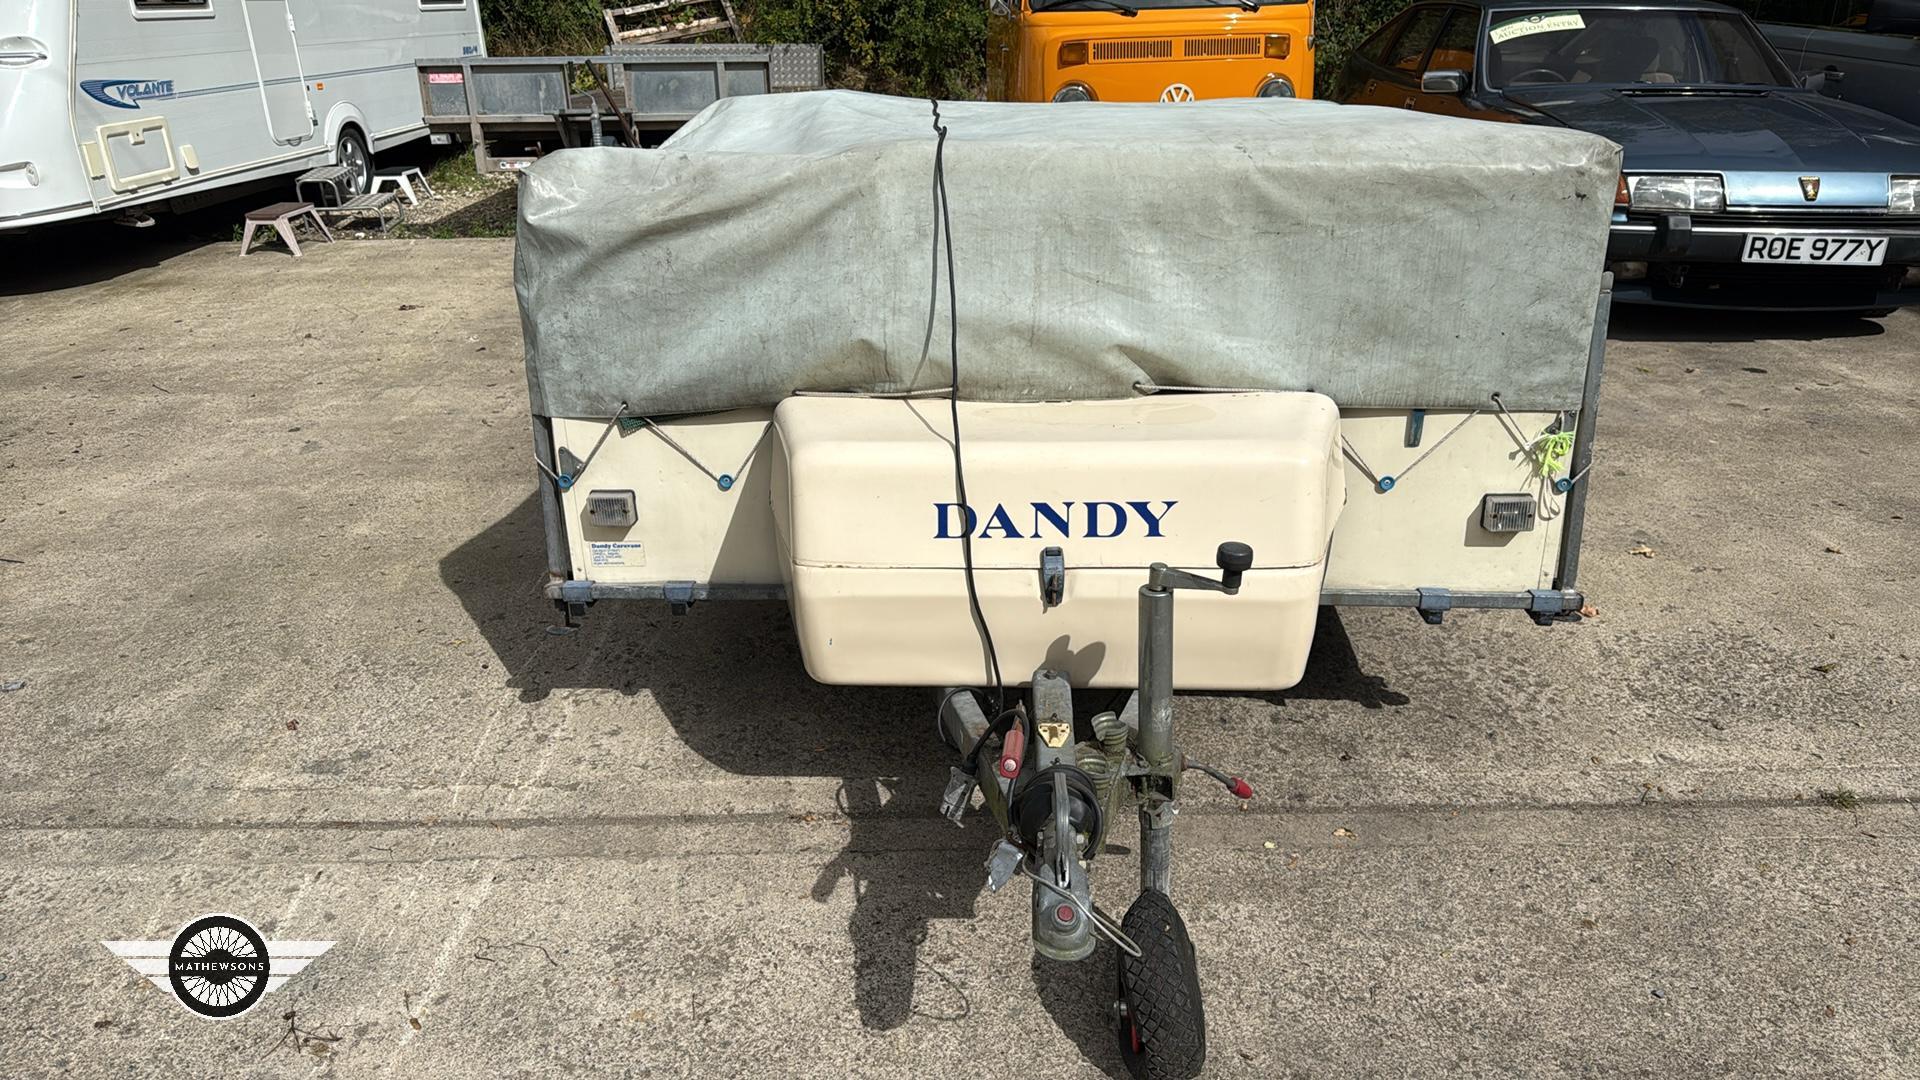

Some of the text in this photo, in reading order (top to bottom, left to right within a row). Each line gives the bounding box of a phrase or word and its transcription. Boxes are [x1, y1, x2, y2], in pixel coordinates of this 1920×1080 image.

[1497, 24, 1544, 40] AUCTION
[116, 80, 174, 100] VOLANTE
[1747, 236, 1884, 261] ROE 977Y
[933, 501, 1178, 539] DANDY
